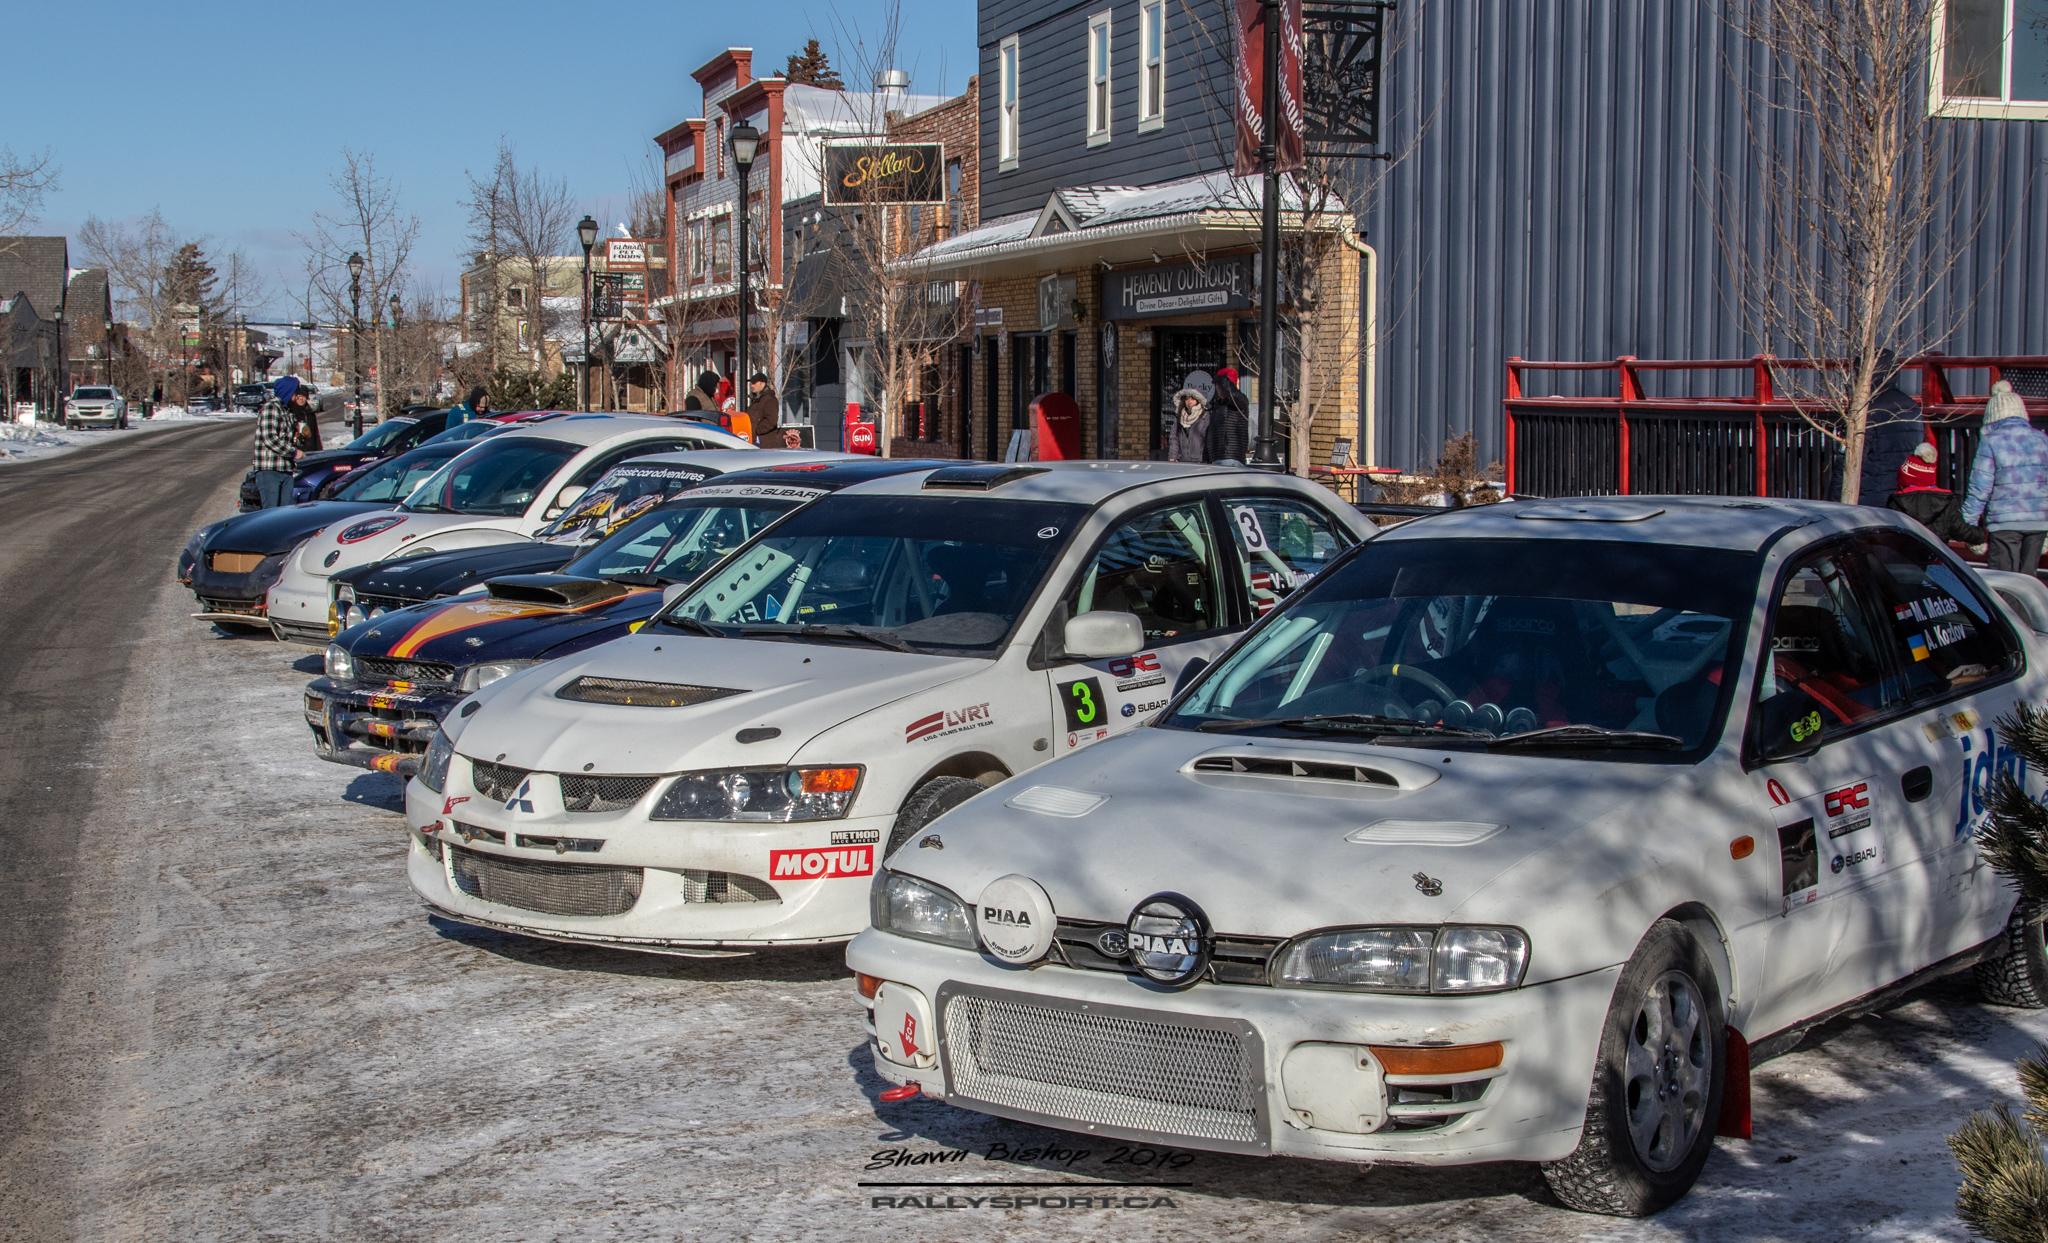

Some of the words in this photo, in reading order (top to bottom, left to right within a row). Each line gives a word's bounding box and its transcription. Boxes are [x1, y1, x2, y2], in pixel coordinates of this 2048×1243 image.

[1122, 272, 1174, 306] HEAVENLY
[1178, 262, 1242, 296] OUTHOUSE
[1140, 301, 1156, 310] Divine
[1158, 299, 1174, 308] Decor
[1178, 295, 1206, 308] Delightful
[1208, 294, 1222, 304] Gifts
[1240, 512, 1262, 548] 3
[1908, 601, 1928, 622] M.
[1926, 597, 1960, 618] Matas
[1772, 635, 1820, 648] parco
[1925, 630, 1936, 650] A.
[1934, 622, 1966, 648] Kozlov
[1072, 681, 1096, 722] 3
[946, 702, 990, 727] LVRT
[923, 734, 938, 742] LIGA
[939, 728, 958, 737] VILNIS
[958, 724, 976, 732] RALLY
[832, 830, 878, 840] METHOD
[774, 850, 870, 876] MOTUL
[1846, 846, 1876, 867] SUBARU
[984, 906, 1031, 925] PIAA
[991, 941, 1008, 954] SUPER
[1009, 945, 1028, 956] RACING
[1128, 933, 1189, 955] PIAA
[906, 1018, 914, 1043] TOW
